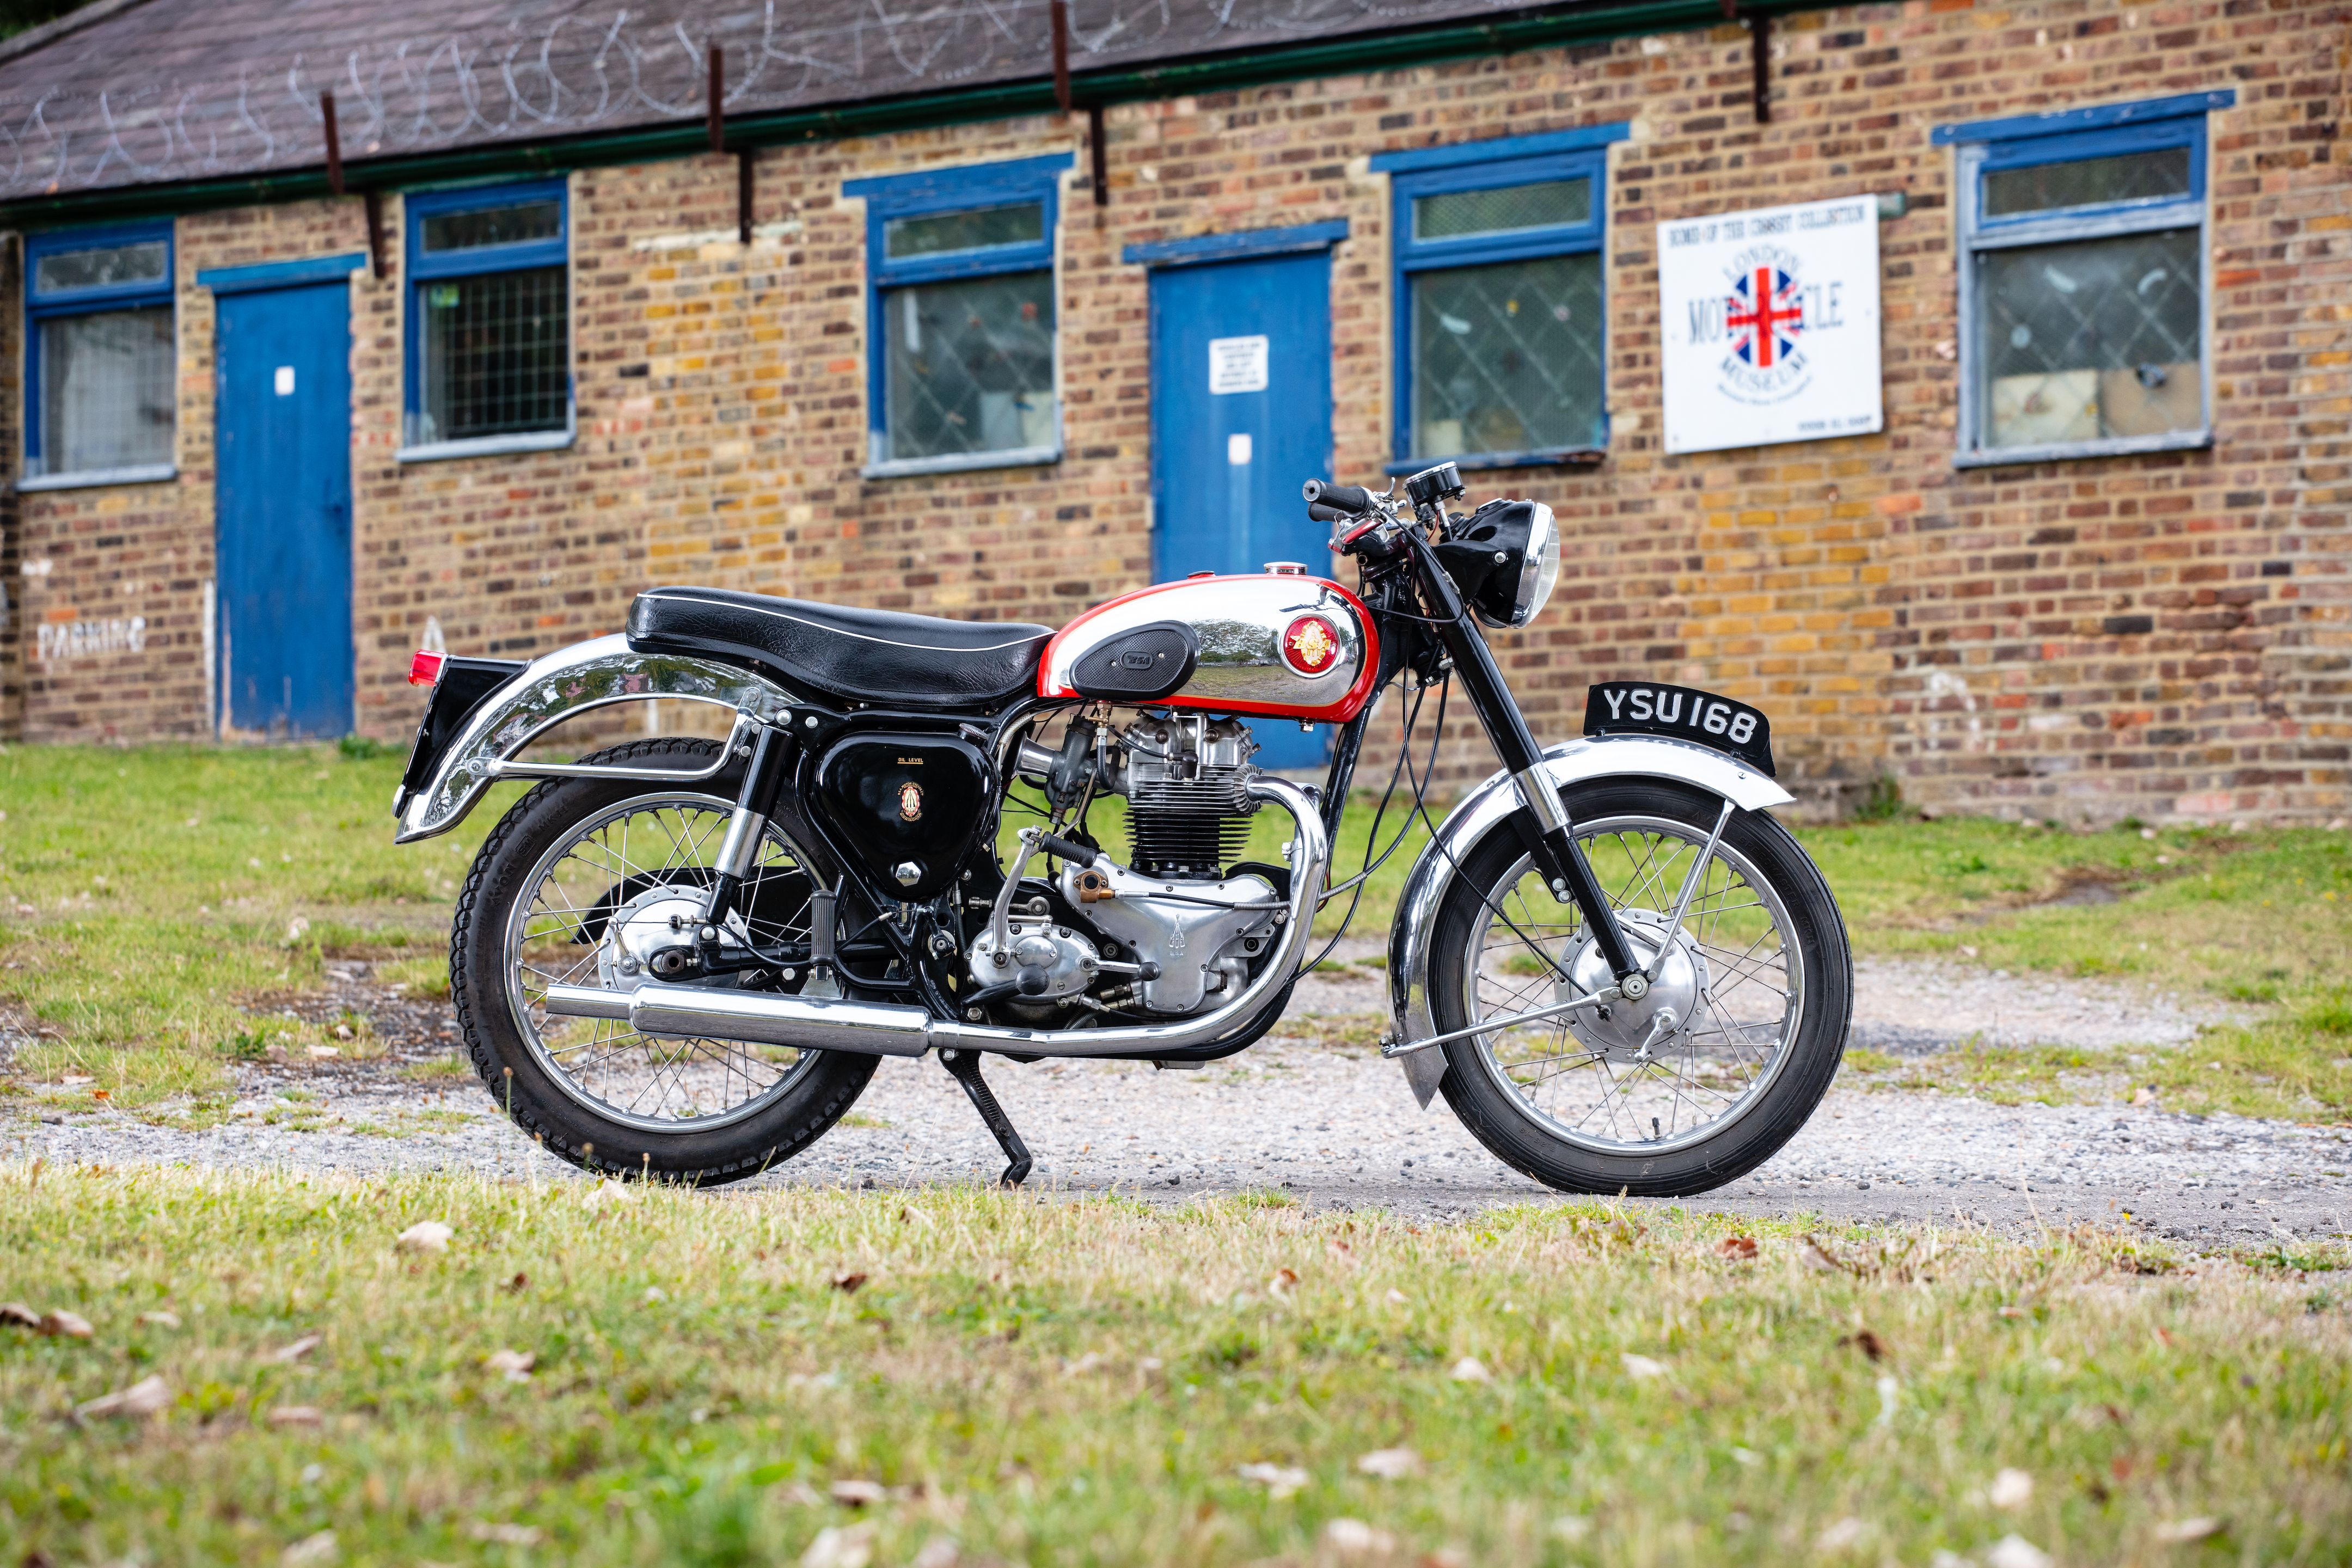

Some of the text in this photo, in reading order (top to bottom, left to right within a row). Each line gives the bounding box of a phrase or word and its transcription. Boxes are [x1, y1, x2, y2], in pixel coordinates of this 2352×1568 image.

[1705, 224, 1718, 242] OF
[1723, 245, 1799, 280] LONDON
[1688, 281, 1843, 344] MOCLE
[1720, 353, 1808, 391] MUSEUM
[1125, 654, 1150, 664] BSA
[1291, 636, 1331, 650] BSA
[1604, 689, 1757, 744] YSU 168
[492, 862, 516, 906] AVON
[1738, 836, 1800, 908] SPEEDMASTER
